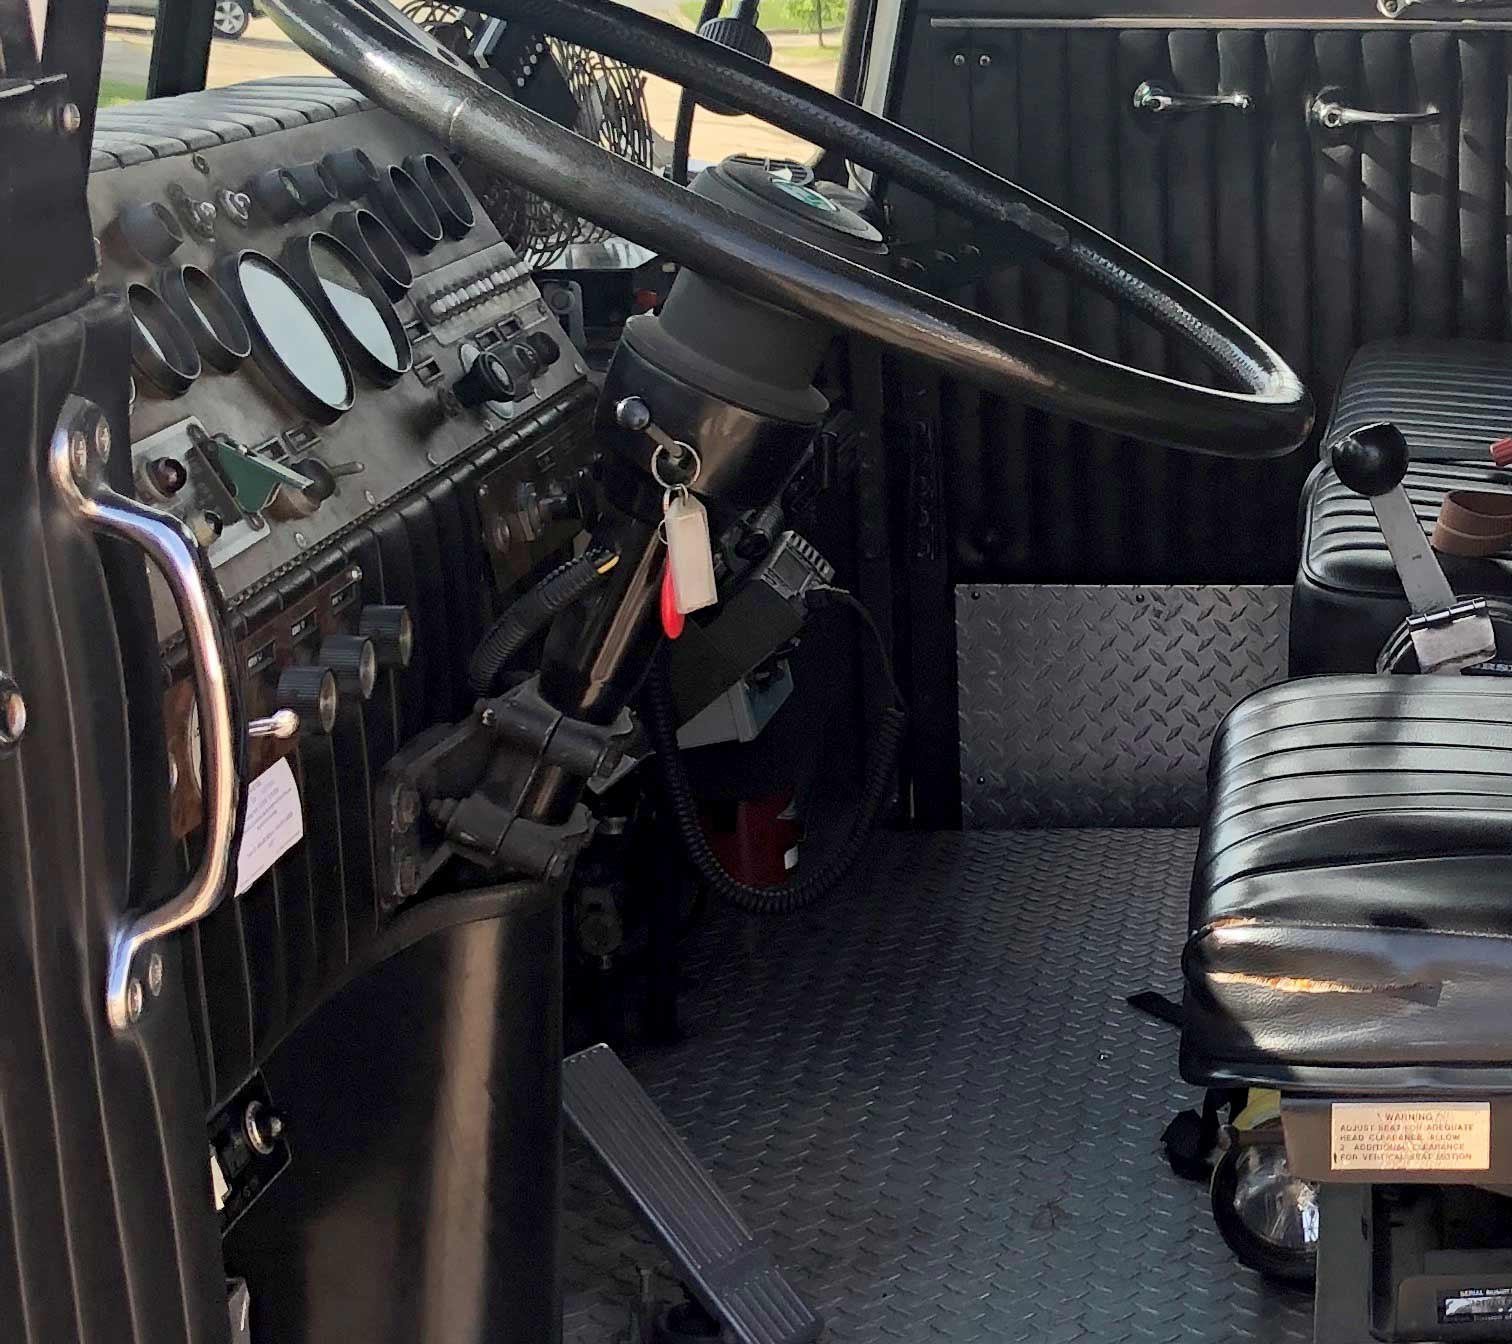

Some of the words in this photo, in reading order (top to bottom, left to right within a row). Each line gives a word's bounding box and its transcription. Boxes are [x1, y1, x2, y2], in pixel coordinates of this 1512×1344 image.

[1385, 1112, 1433, 1121] WARNING
[1340, 1124, 1374, 1132] ADJUST
[1378, 1124, 1401, 1132] SEAT
[1405, 1124, 1422, 1132] FOR
[1427, 1123, 1474, 1131] ADEQUATE
[1340, 1134, 1364, 1142] HEAD
[1429, 1133, 1461, 1141] ALLOW
[1354, 1143, 1405, 1151] ADDITIONAL
[1340, 1153, 1358, 1161] FOR
[1362, 1153, 1404, 1161] VERTICAL
[1410, 1153, 1432, 1161] SEAT
[1436, 1152, 1473, 1160] MOTION
